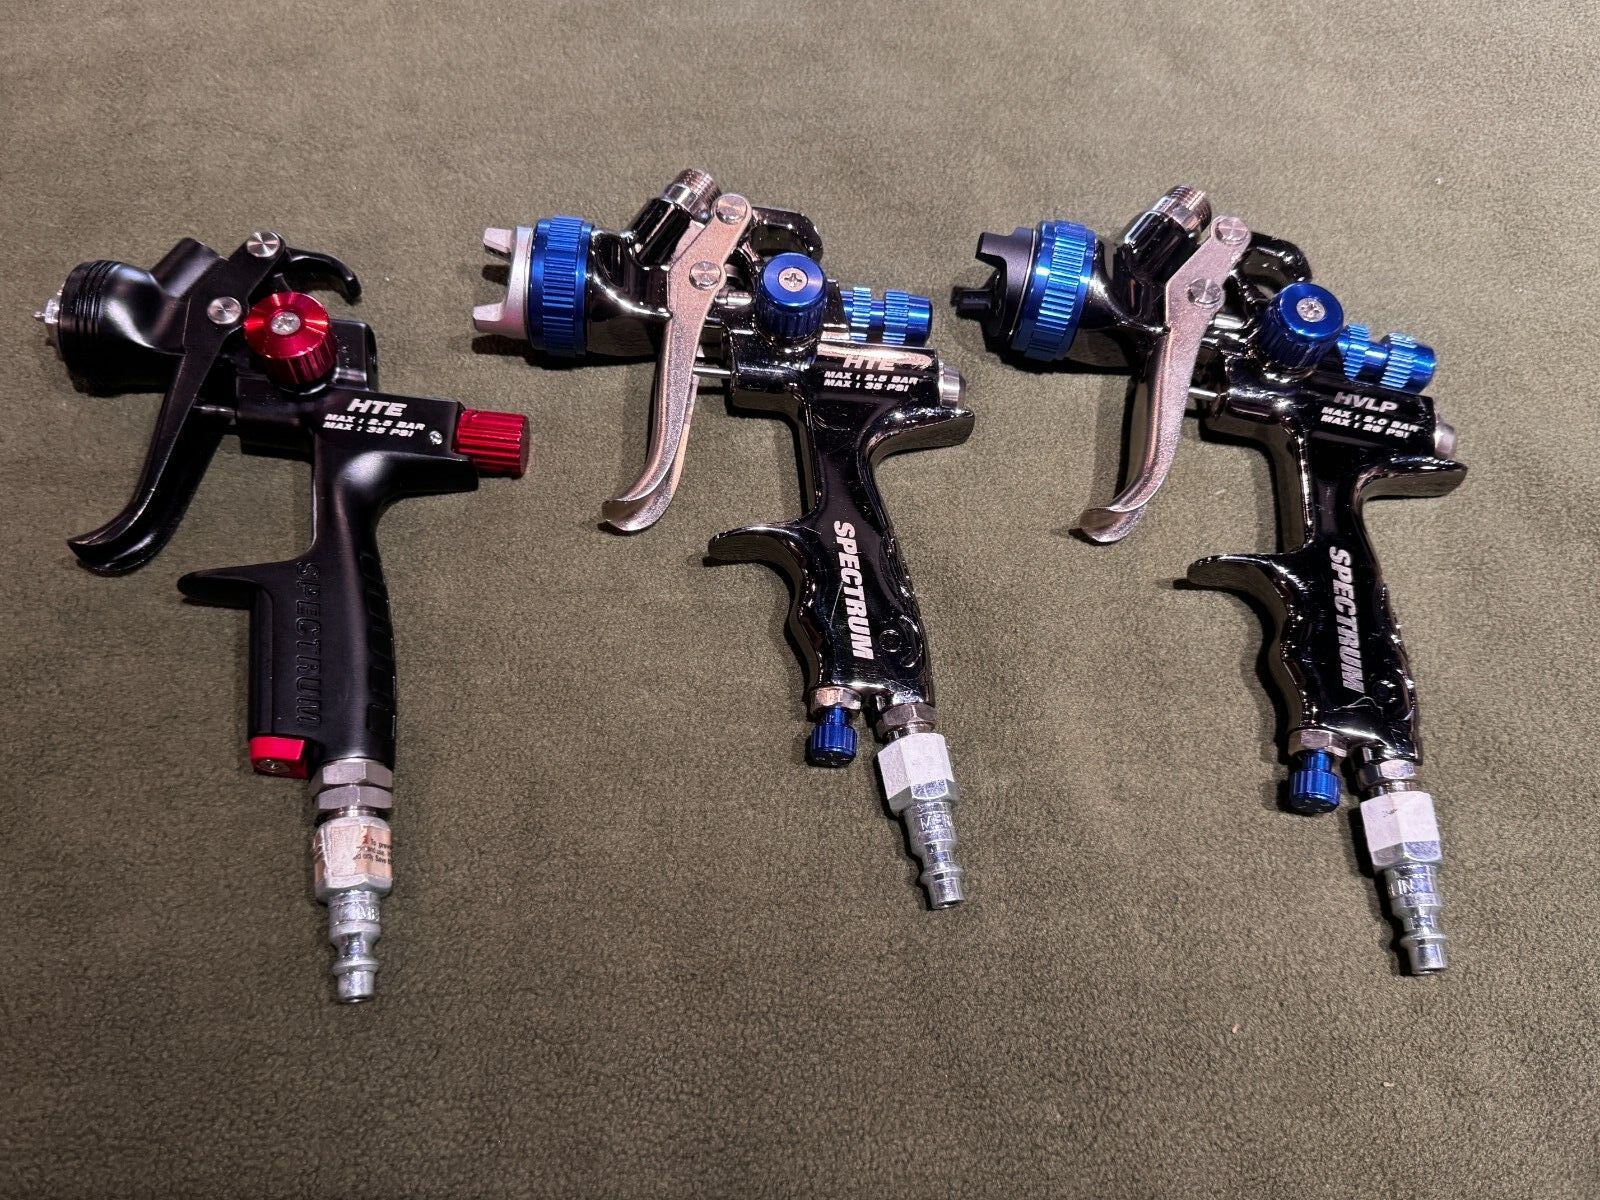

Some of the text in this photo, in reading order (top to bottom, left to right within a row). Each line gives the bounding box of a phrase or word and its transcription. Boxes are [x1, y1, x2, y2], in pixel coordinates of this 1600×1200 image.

[843, 354, 895, 372] HTE
[823, 371, 853, 380] MAX
[864, 374, 888, 383] 2.5
[891, 376, 919, 386] BAR
[823, 379, 853, 388] MAX
[864, 383, 883, 391] 35
[886, 384, 909, 393] PSI
[347, 398, 408, 417] HTE
[1333, 391, 1399, 413] HVLP
[322, 421, 354, 431] MAX
[366, 426, 386, 434] 35
[388, 428, 415, 438] PSI
[324, 413, 356, 424] MAX
[367, 418, 394, 427] 2.5
[396, 421, 426, 431] BAR
[1320, 414, 1352, 427] MAX
[1385, 428, 1411, 440] PSI
[1321, 406, 1353, 419] MAX
[1390, 420, 1420, 433] BAR
[833, 520, 875, 660] SPECTRUM
[1329, 546, 1366, 694] SPECTRUM
[296, 561, 321, 727] SPECTRUM
